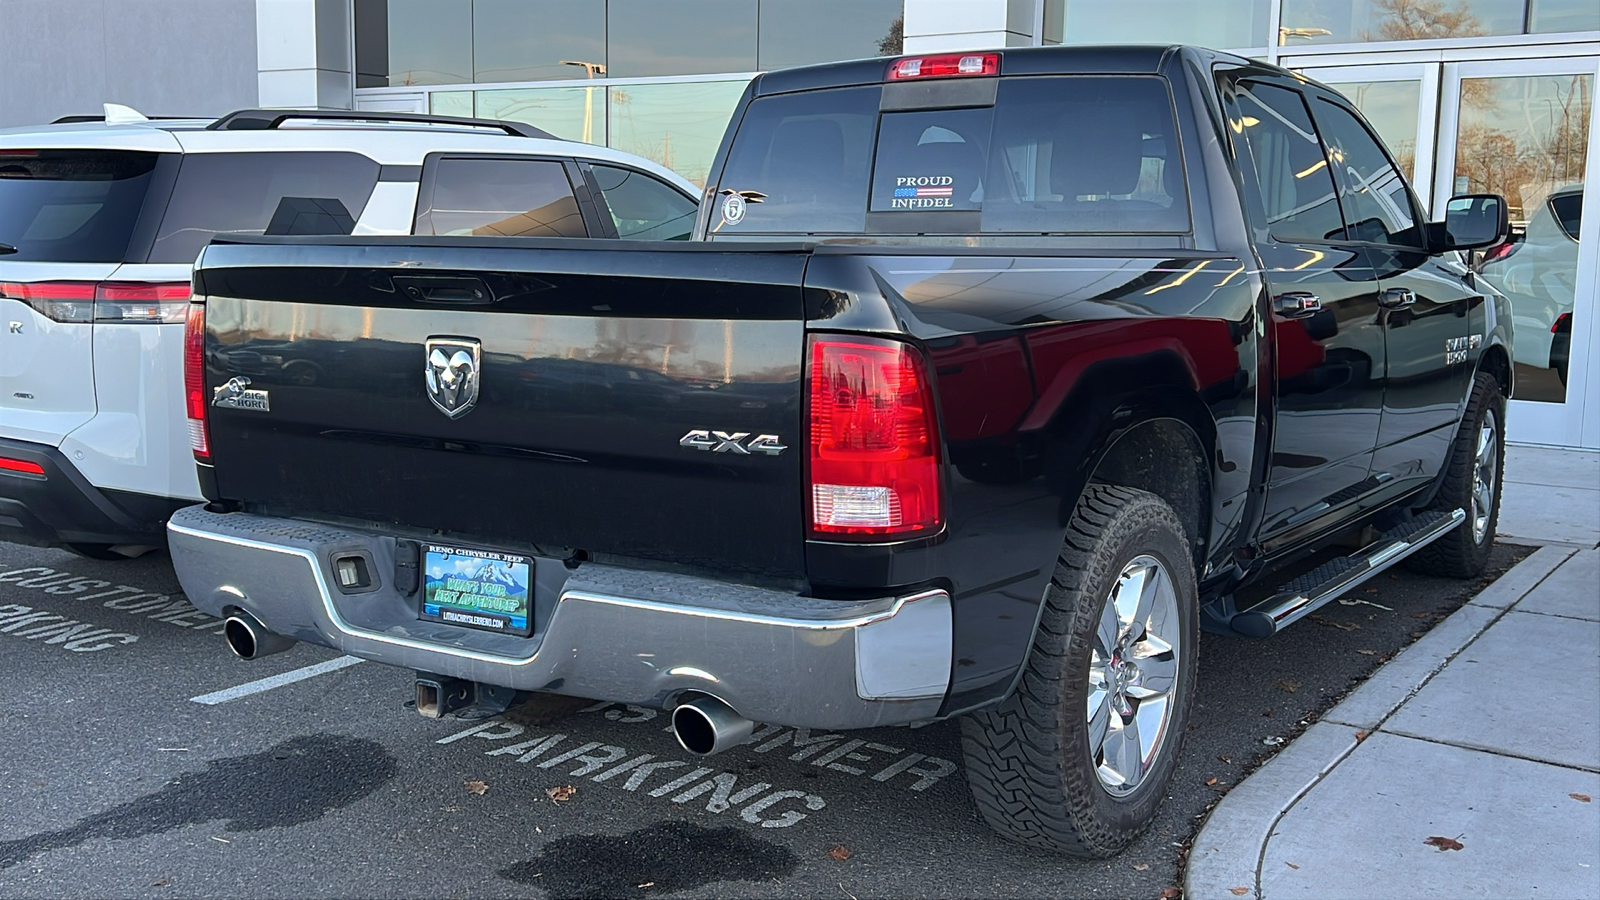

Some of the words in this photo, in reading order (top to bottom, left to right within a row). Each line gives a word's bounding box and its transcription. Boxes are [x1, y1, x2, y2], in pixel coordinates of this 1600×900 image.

[896, 176, 953, 186] PROUD
[891, 198, 954, 210] INFIDEL
[237, 399, 266, 409] HORN
[244, 392, 261, 400] BIG
[680, 430, 788, 455] 4X4
[429, 545, 454, 555] RENO
[455, 549, 501, 561] CHRYSLER
[503, 555, 524, 563] JEEP
[447, 577, 479, 593] WHAT'S
[480, 582, 506, 597] YOUR
[434, 589, 460, 604] NEXT
[458, 593, 520, 612] ADVENTURE?
[436, 720, 825, 828] PARKING
